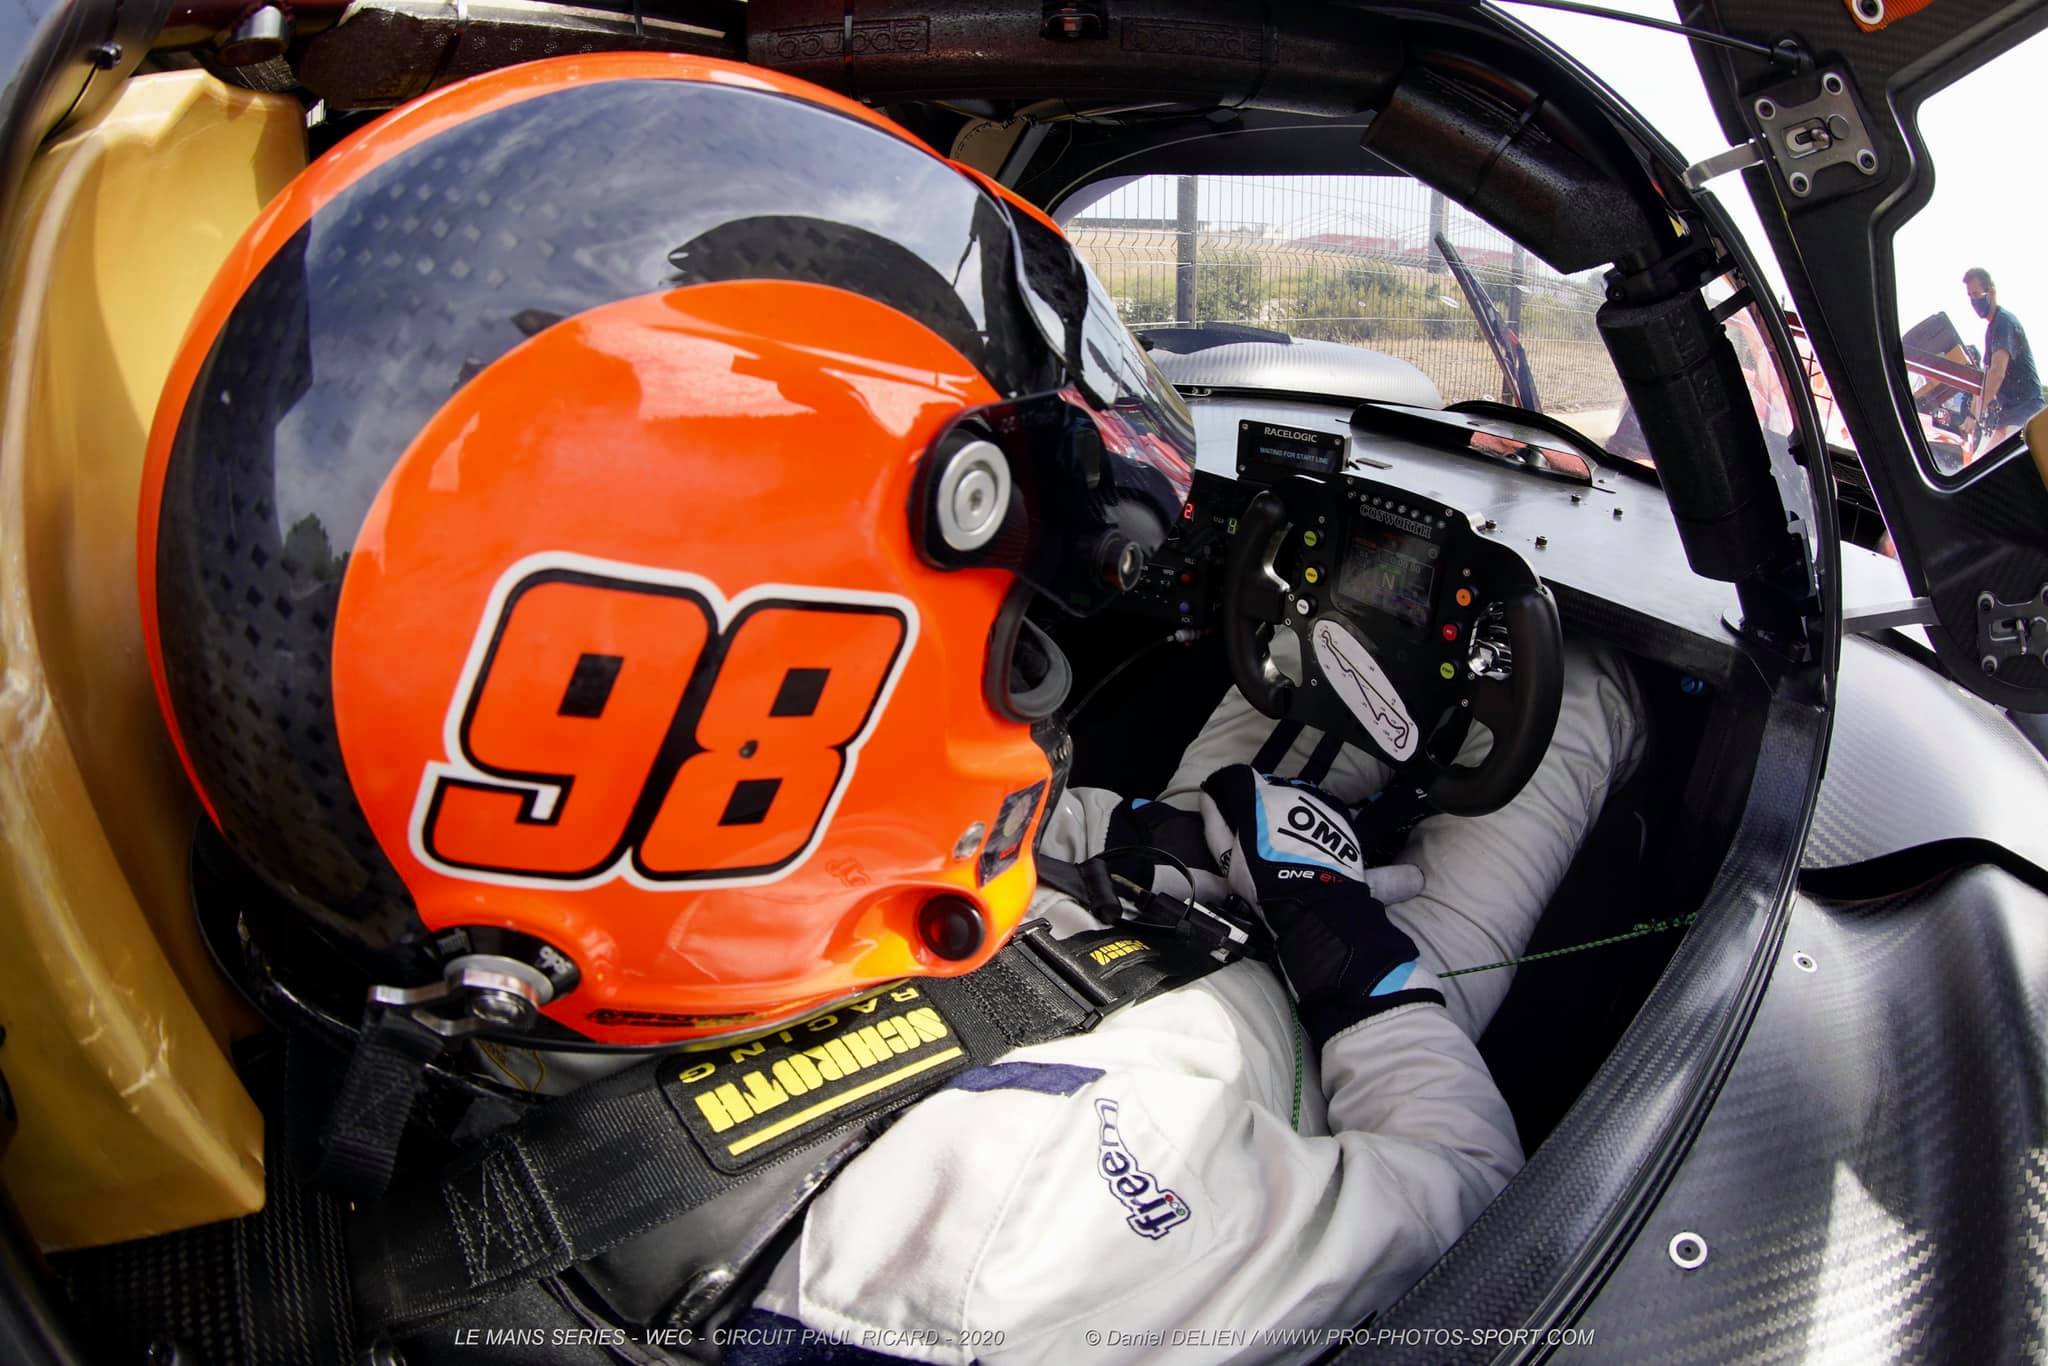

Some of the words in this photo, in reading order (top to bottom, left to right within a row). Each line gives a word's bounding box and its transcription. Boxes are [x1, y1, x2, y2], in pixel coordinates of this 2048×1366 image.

[1264, 426, 1318, 443] RACELOGIC
[1360, 503, 1433, 539] COSWORTH
[409, 552, 920, 890] 98
[1287, 805, 1358, 862] OMP
[678, 987, 920, 1083] RACING
[694, 1007, 949, 1133] SCHROTH
[1099, 1103, 1185, 1234] freem
